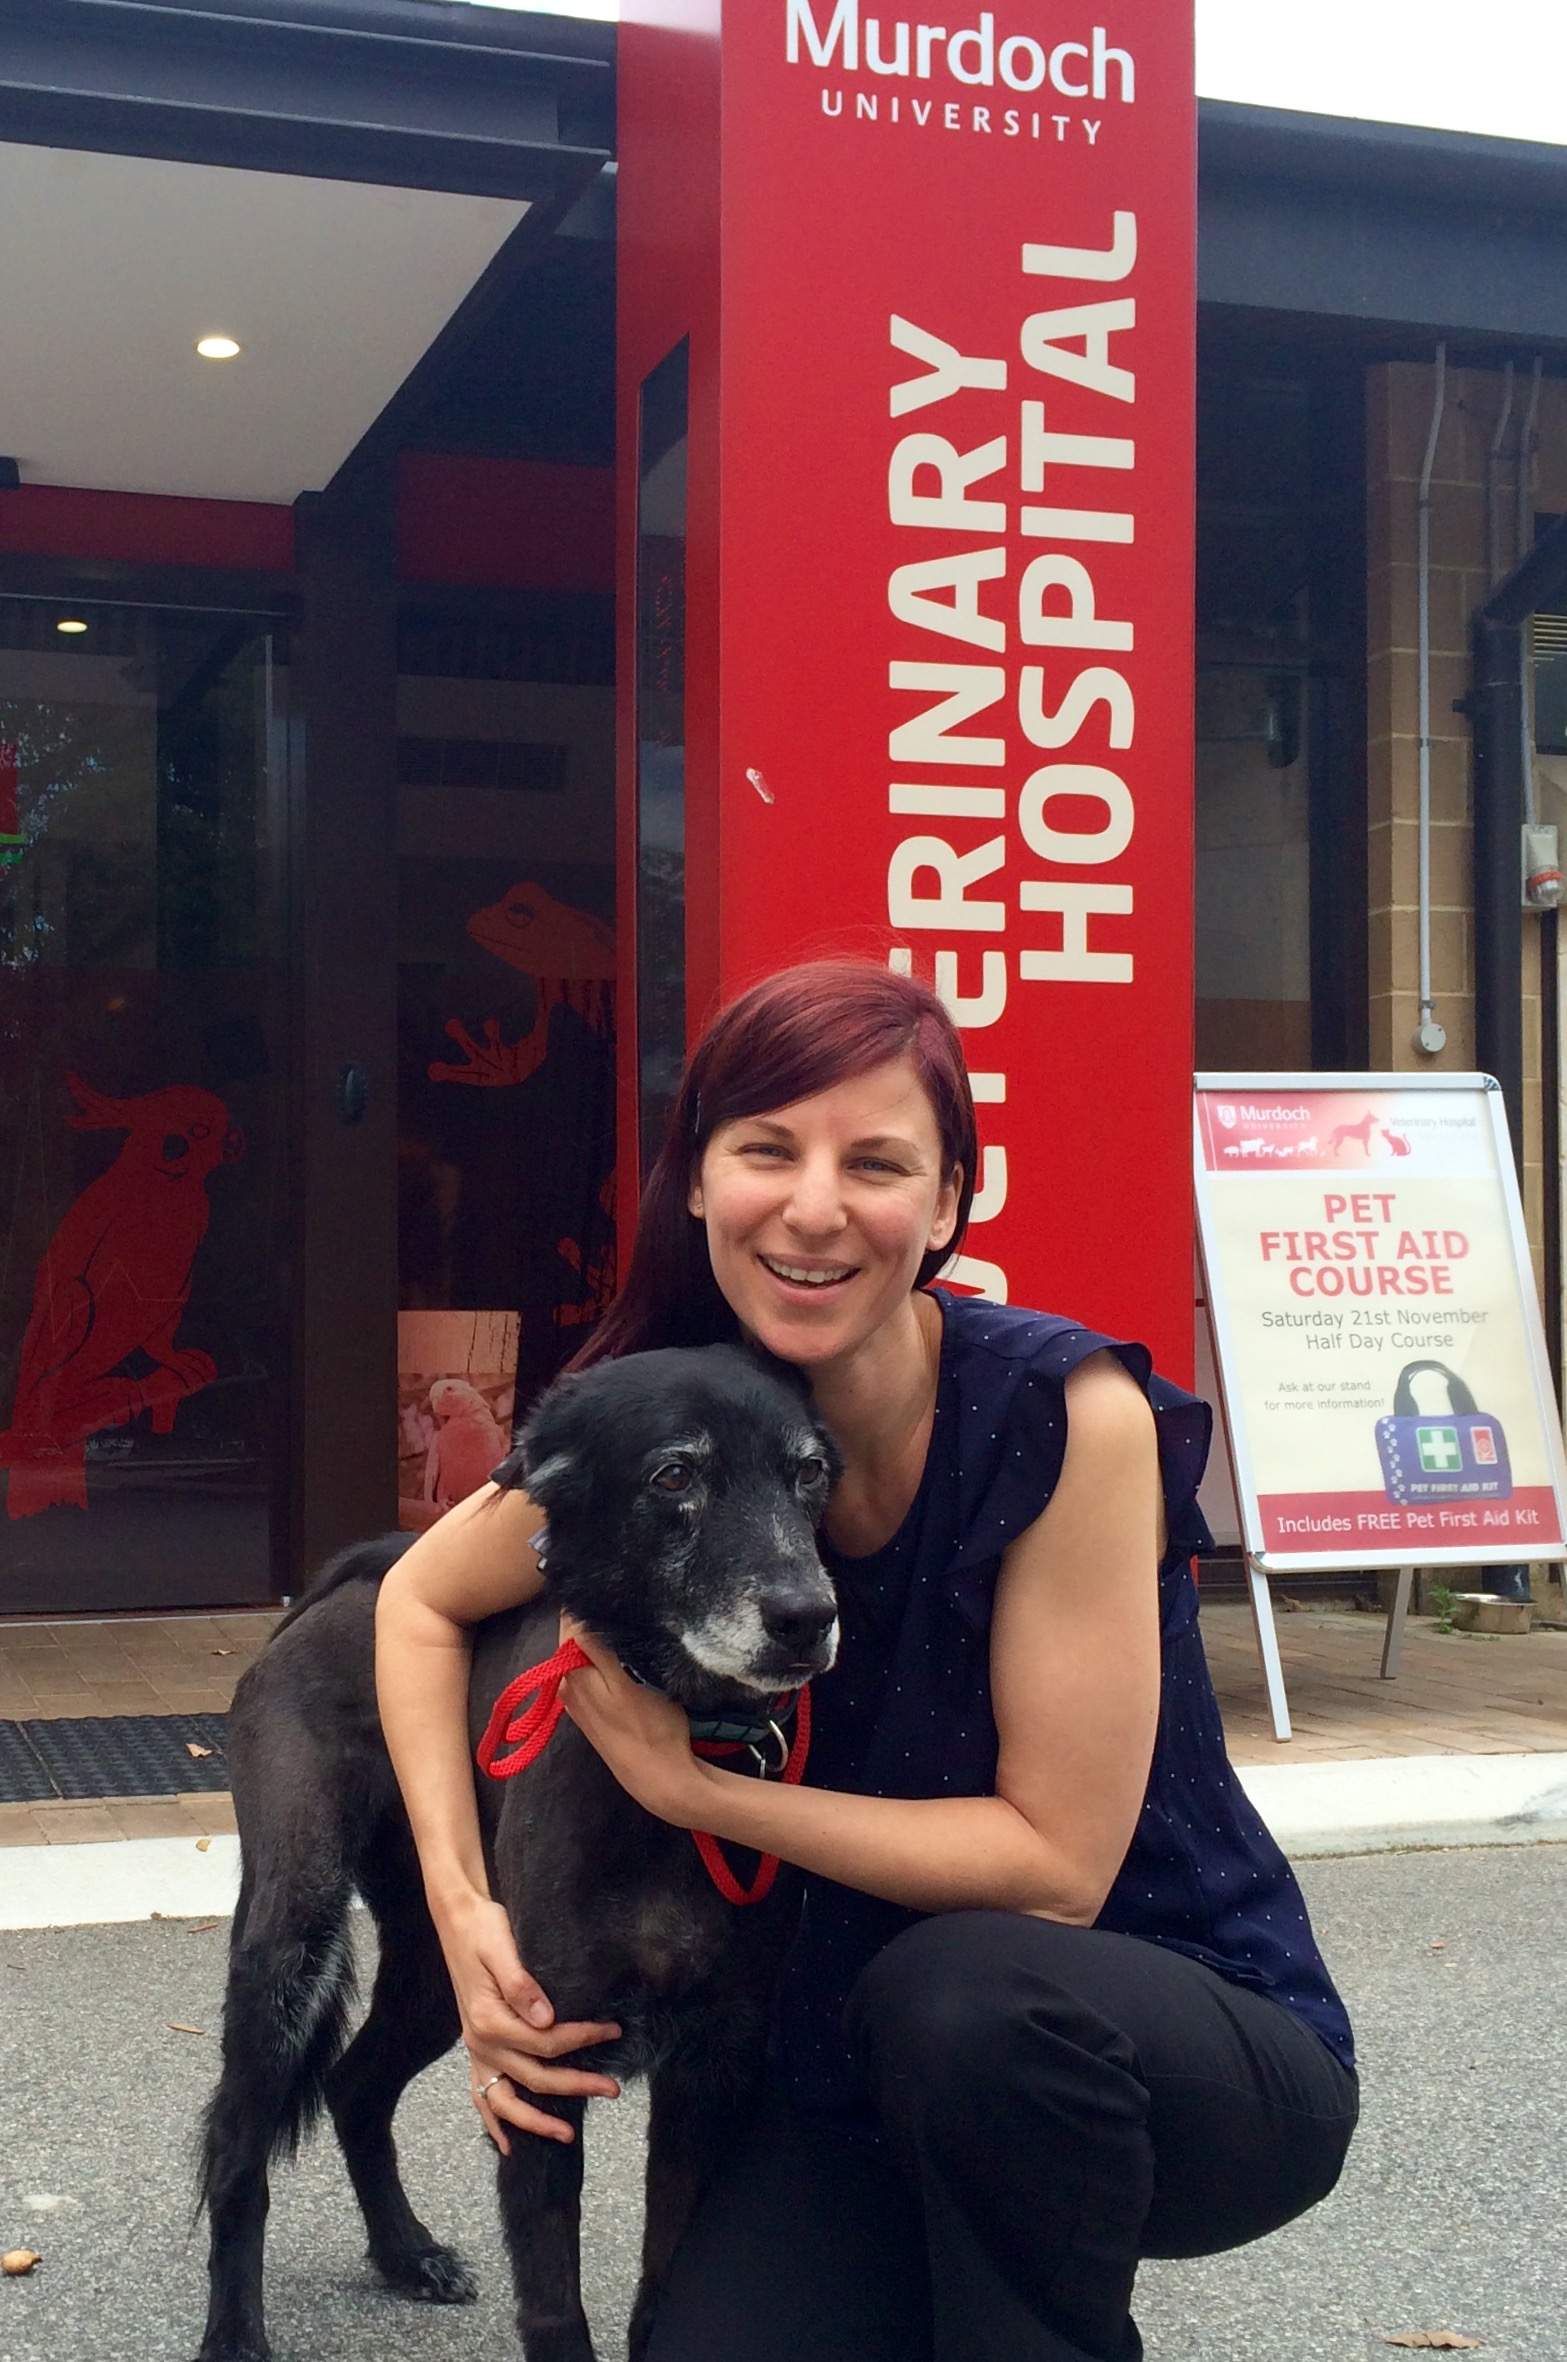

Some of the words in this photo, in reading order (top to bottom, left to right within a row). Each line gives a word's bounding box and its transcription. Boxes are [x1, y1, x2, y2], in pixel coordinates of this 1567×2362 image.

[786, 0, 1135, 103] Murdoch
[821, 89, 1102, 145] UNIVERSITY
[1018, 210, 1137, 983] HOSPITAL
[1240, 1105, 1311, 1121] Murdoch
[1324, 1194, 1396, 1223] PET
[1260, 1231, 1380, 1261] FIRST
[1396, 1230, 1470, 1260] AID
[1289, 1265, 1454, 1297] COURSE
[1262, 1311, 1344, 1328] Saturday
[1352, 1310, 1392, 1326] 21st
[1397, 1308, 1489, 1325] November
[1306, 1333, 1343, 1350] Half
[1348, 1334, 1384, 1352] Day
[1391, 1332, 1454, 1348] Course
[1278, 1381, 1299, 1393] Ask
[1302, 1381, 1314, 1392] at
[1317, 1382, 1337, 1392] our
[1340, 1379, 1371, 1391] stand
[1264, 1400, 1280, 1410] for
[1284, 1401, 1313, 1410] more
[1410, 1483, 1429, 1493] PET
[1431, 1483, 1458, 1493] FIRST
[1460, 1482, 1479, 1492] AID
[1482, 1481, 1499, 1491] KIT
[1278, 1515, 1351, 1534] Includes
[1357, 1513, 1400, 1531] FREE
[1407, 1512, 1435, 1529] Pet
[1439, 1510, 1477, 1528] First
[1483, 1509, 1510, 1527] Aid
[1515, 1508, 1539, 1526] Kit
